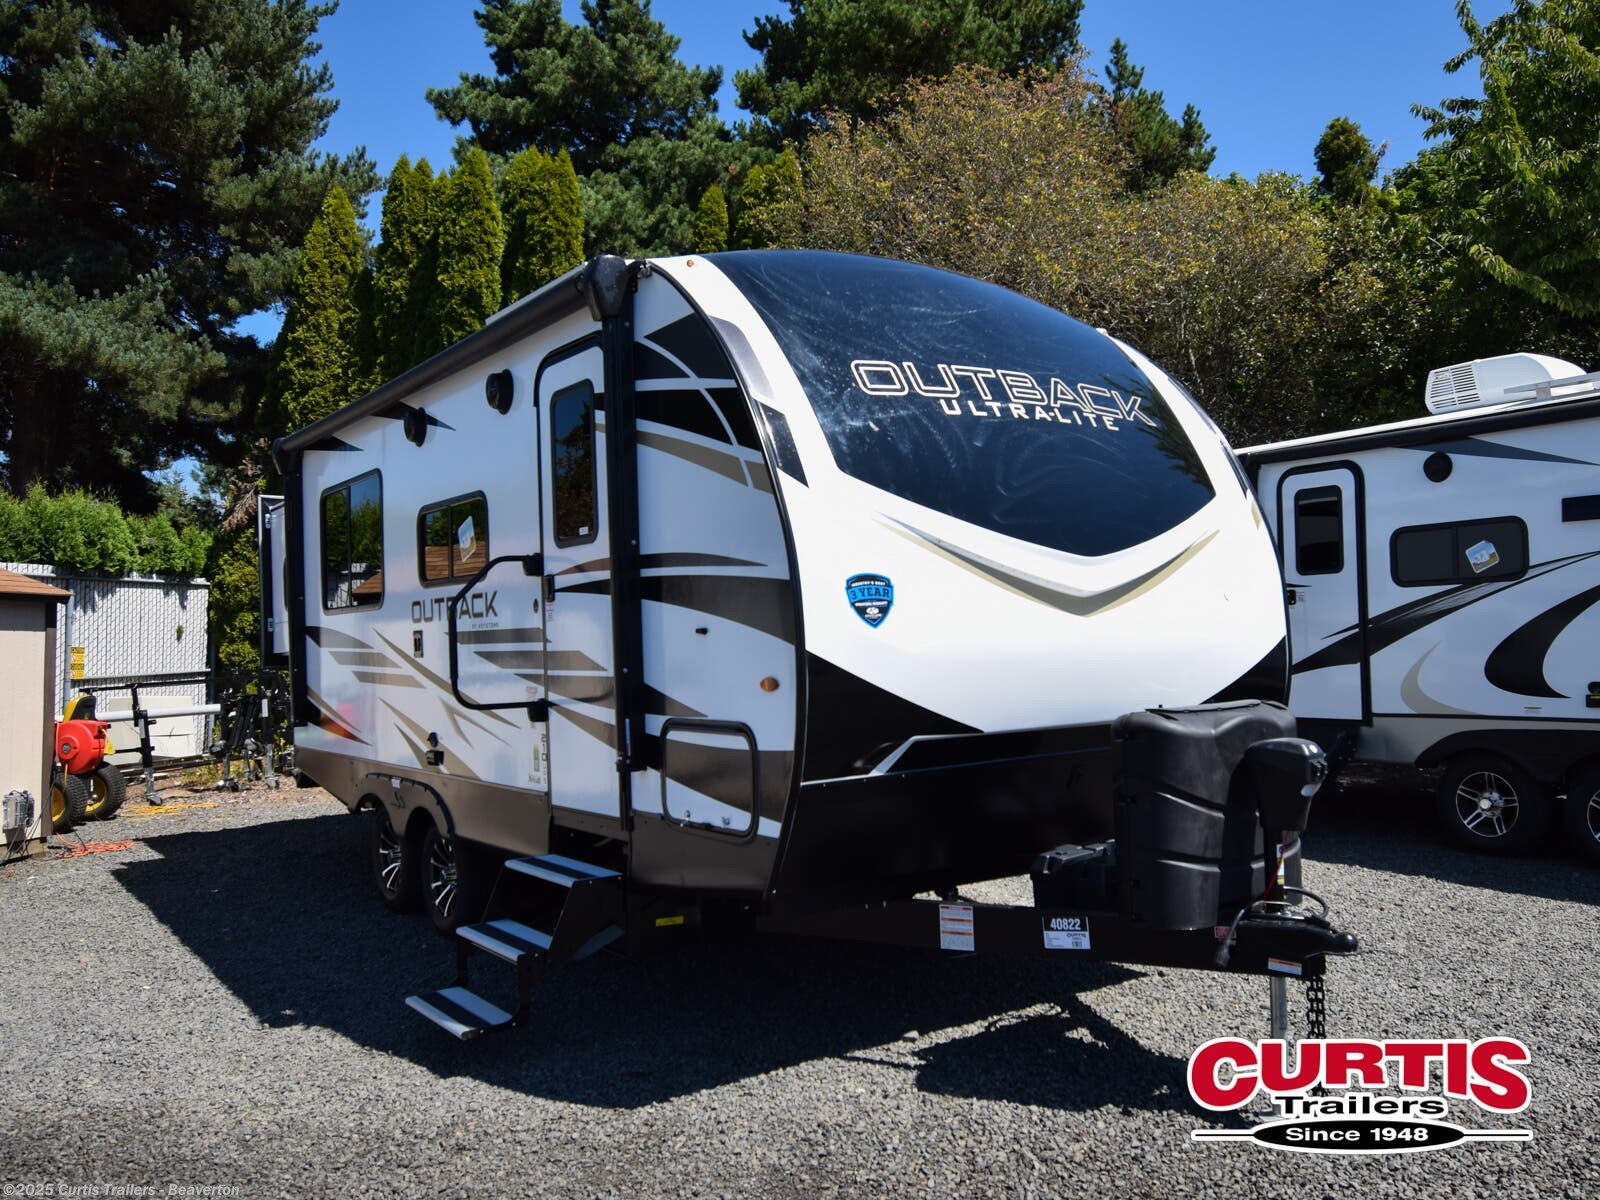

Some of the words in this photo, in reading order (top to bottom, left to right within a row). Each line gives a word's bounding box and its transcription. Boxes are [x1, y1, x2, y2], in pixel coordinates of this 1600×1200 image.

[851, 359, 1156, 427] OUTBACK
[940, 398, 1119, 431] ULTRA-LITE
[850, 590, 857, 600] 3
[859, 587, 890, 598] YEAR
[1050, 917, 1081, 930] 40822
